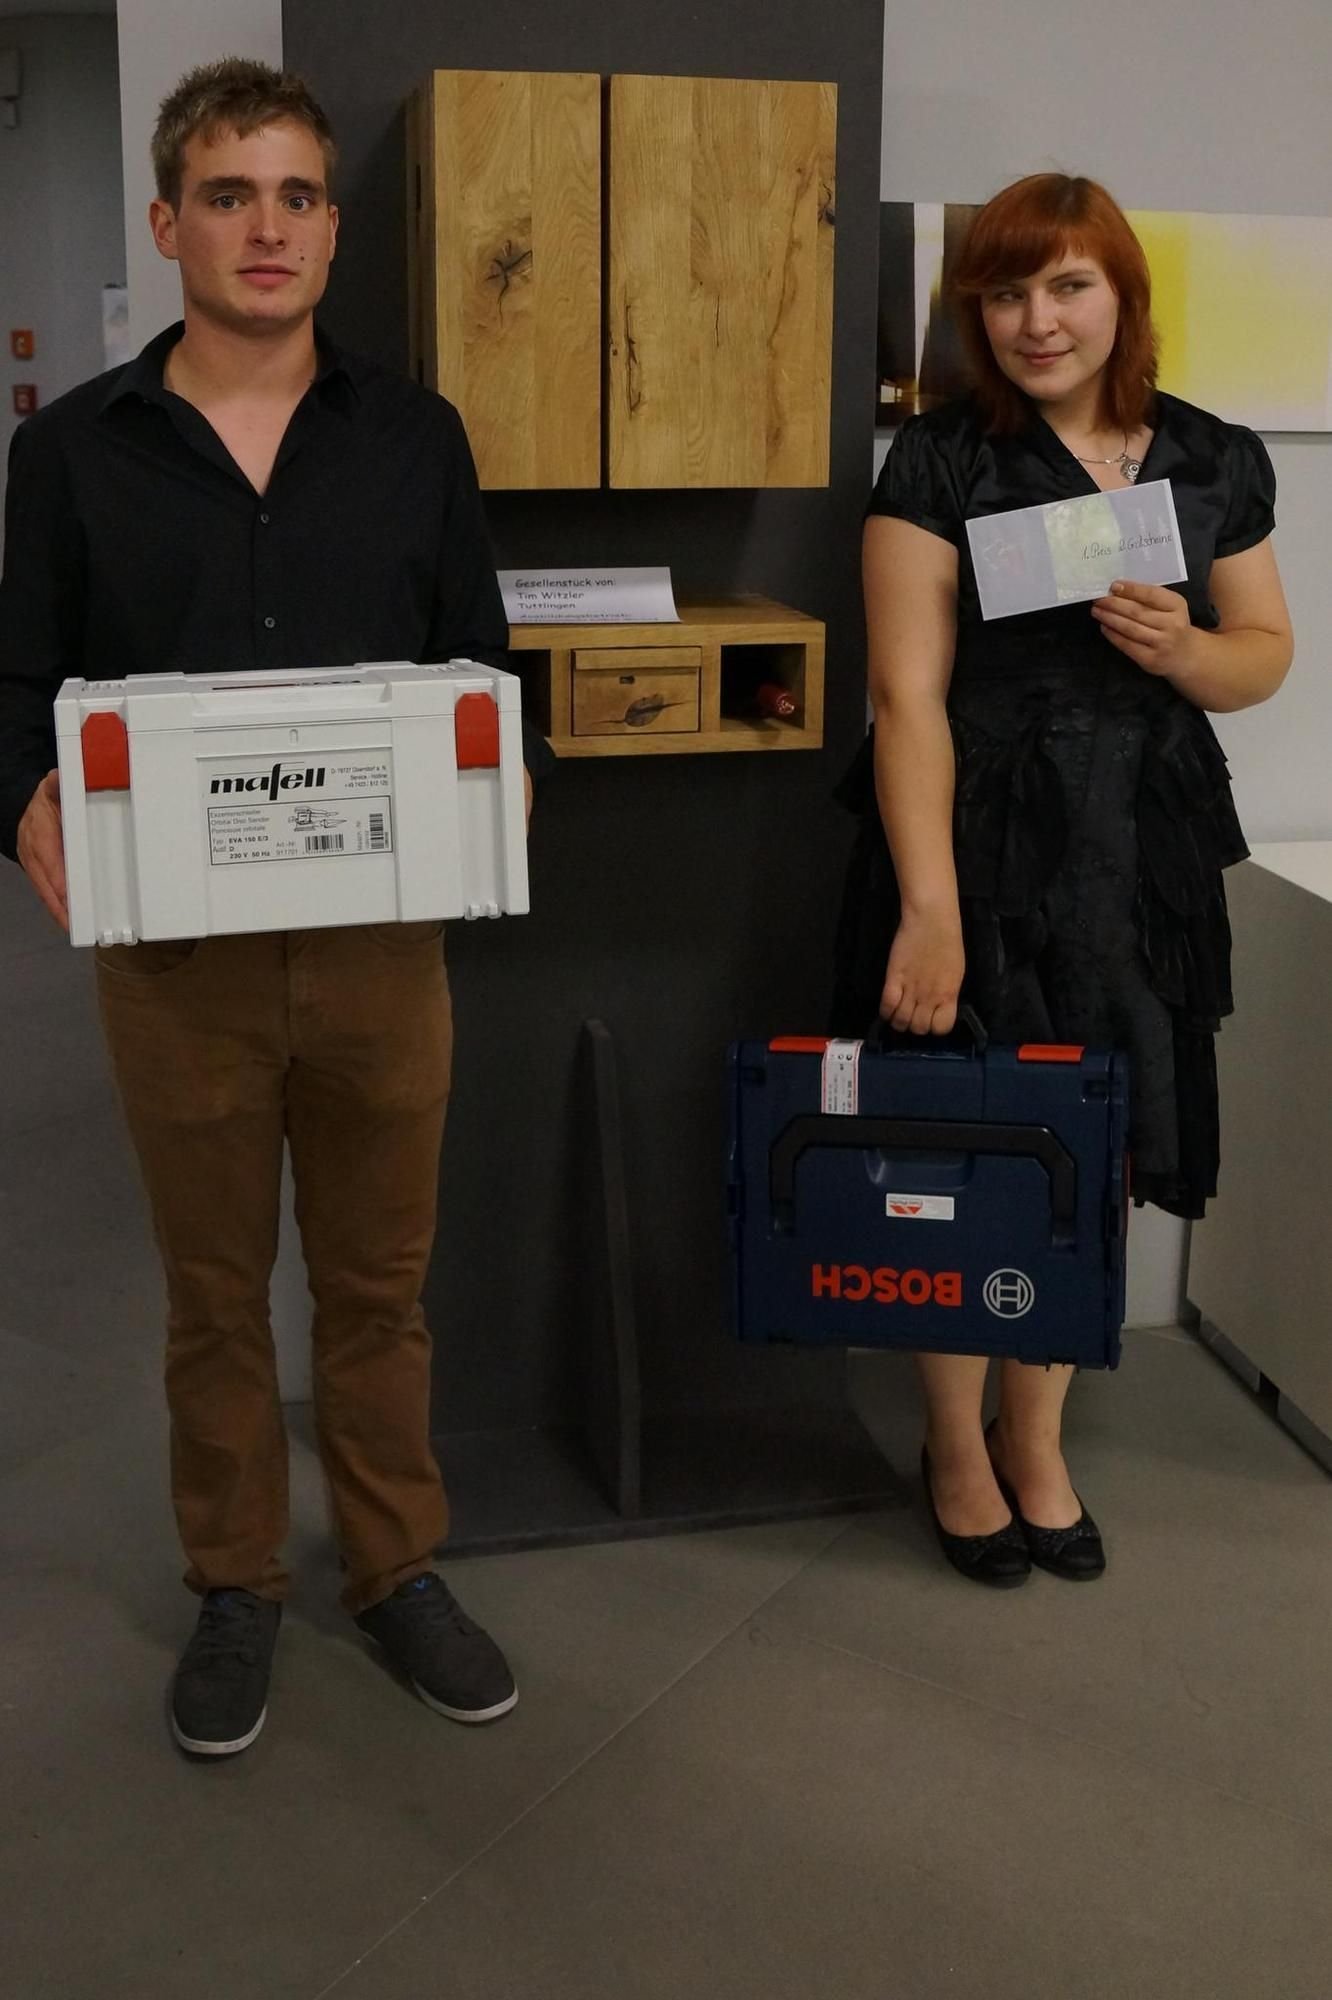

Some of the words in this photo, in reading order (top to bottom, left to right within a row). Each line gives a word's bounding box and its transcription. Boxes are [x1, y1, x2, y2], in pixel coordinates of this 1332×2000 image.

[517, 591, 538, 600] Tim
[541, 590, 585, 600] Witzler
[517, 602, 576, 610] Tuttlingen
[210, 763, 326, 801] mafell
[812, 1263, 962, 1307] BOSCH
